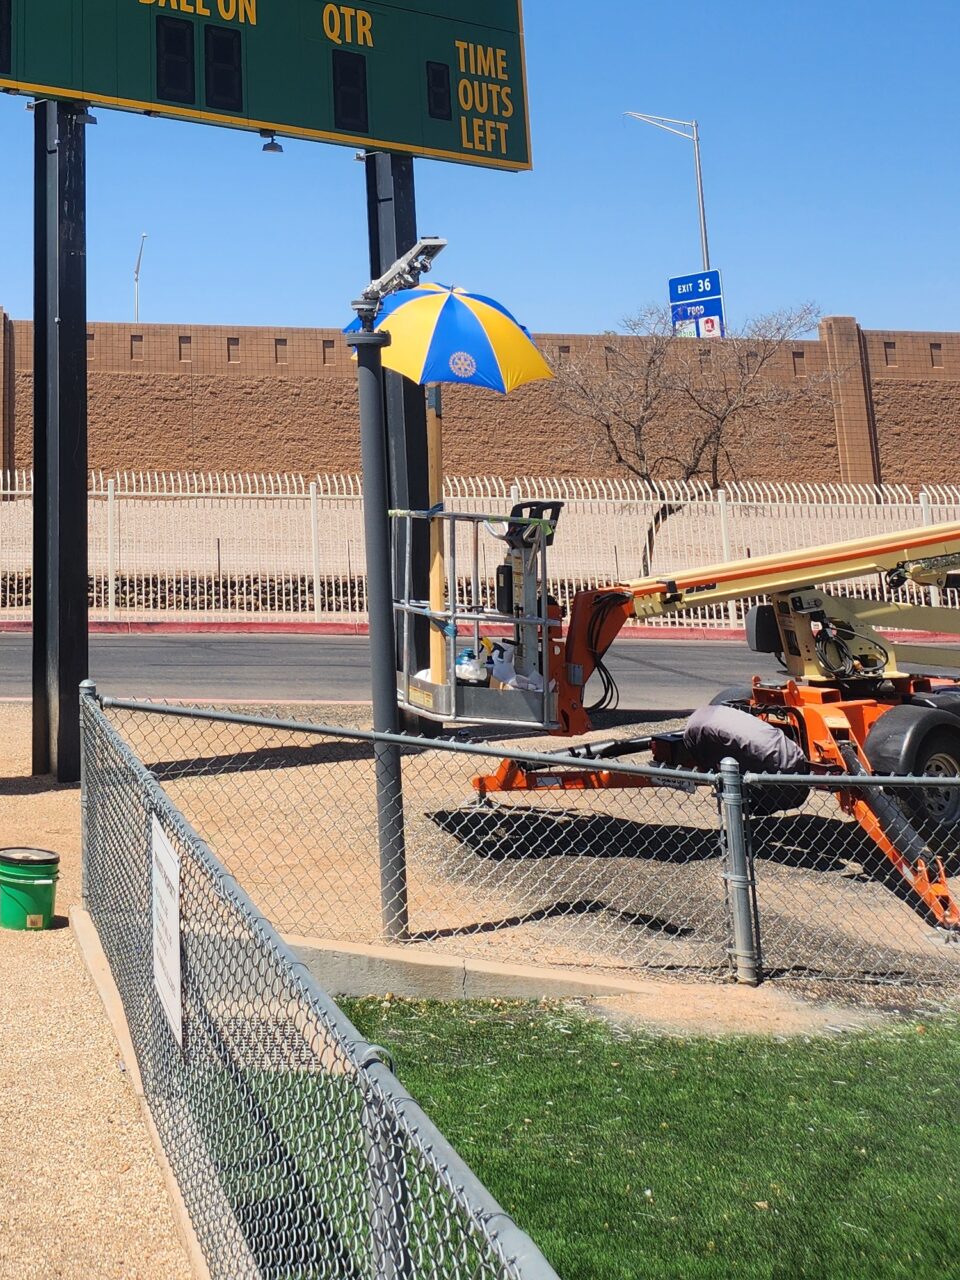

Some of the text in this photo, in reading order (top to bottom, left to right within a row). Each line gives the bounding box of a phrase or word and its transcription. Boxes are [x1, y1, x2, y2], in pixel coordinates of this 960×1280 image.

[322, 3, 374, 47] QTR
[455, 40, 509, 80] TIME
[458, 78, 514, 118] OUTS
[460, 116, 509, 154] LEFT
[677, 278, 711, 294] EXIT 36
